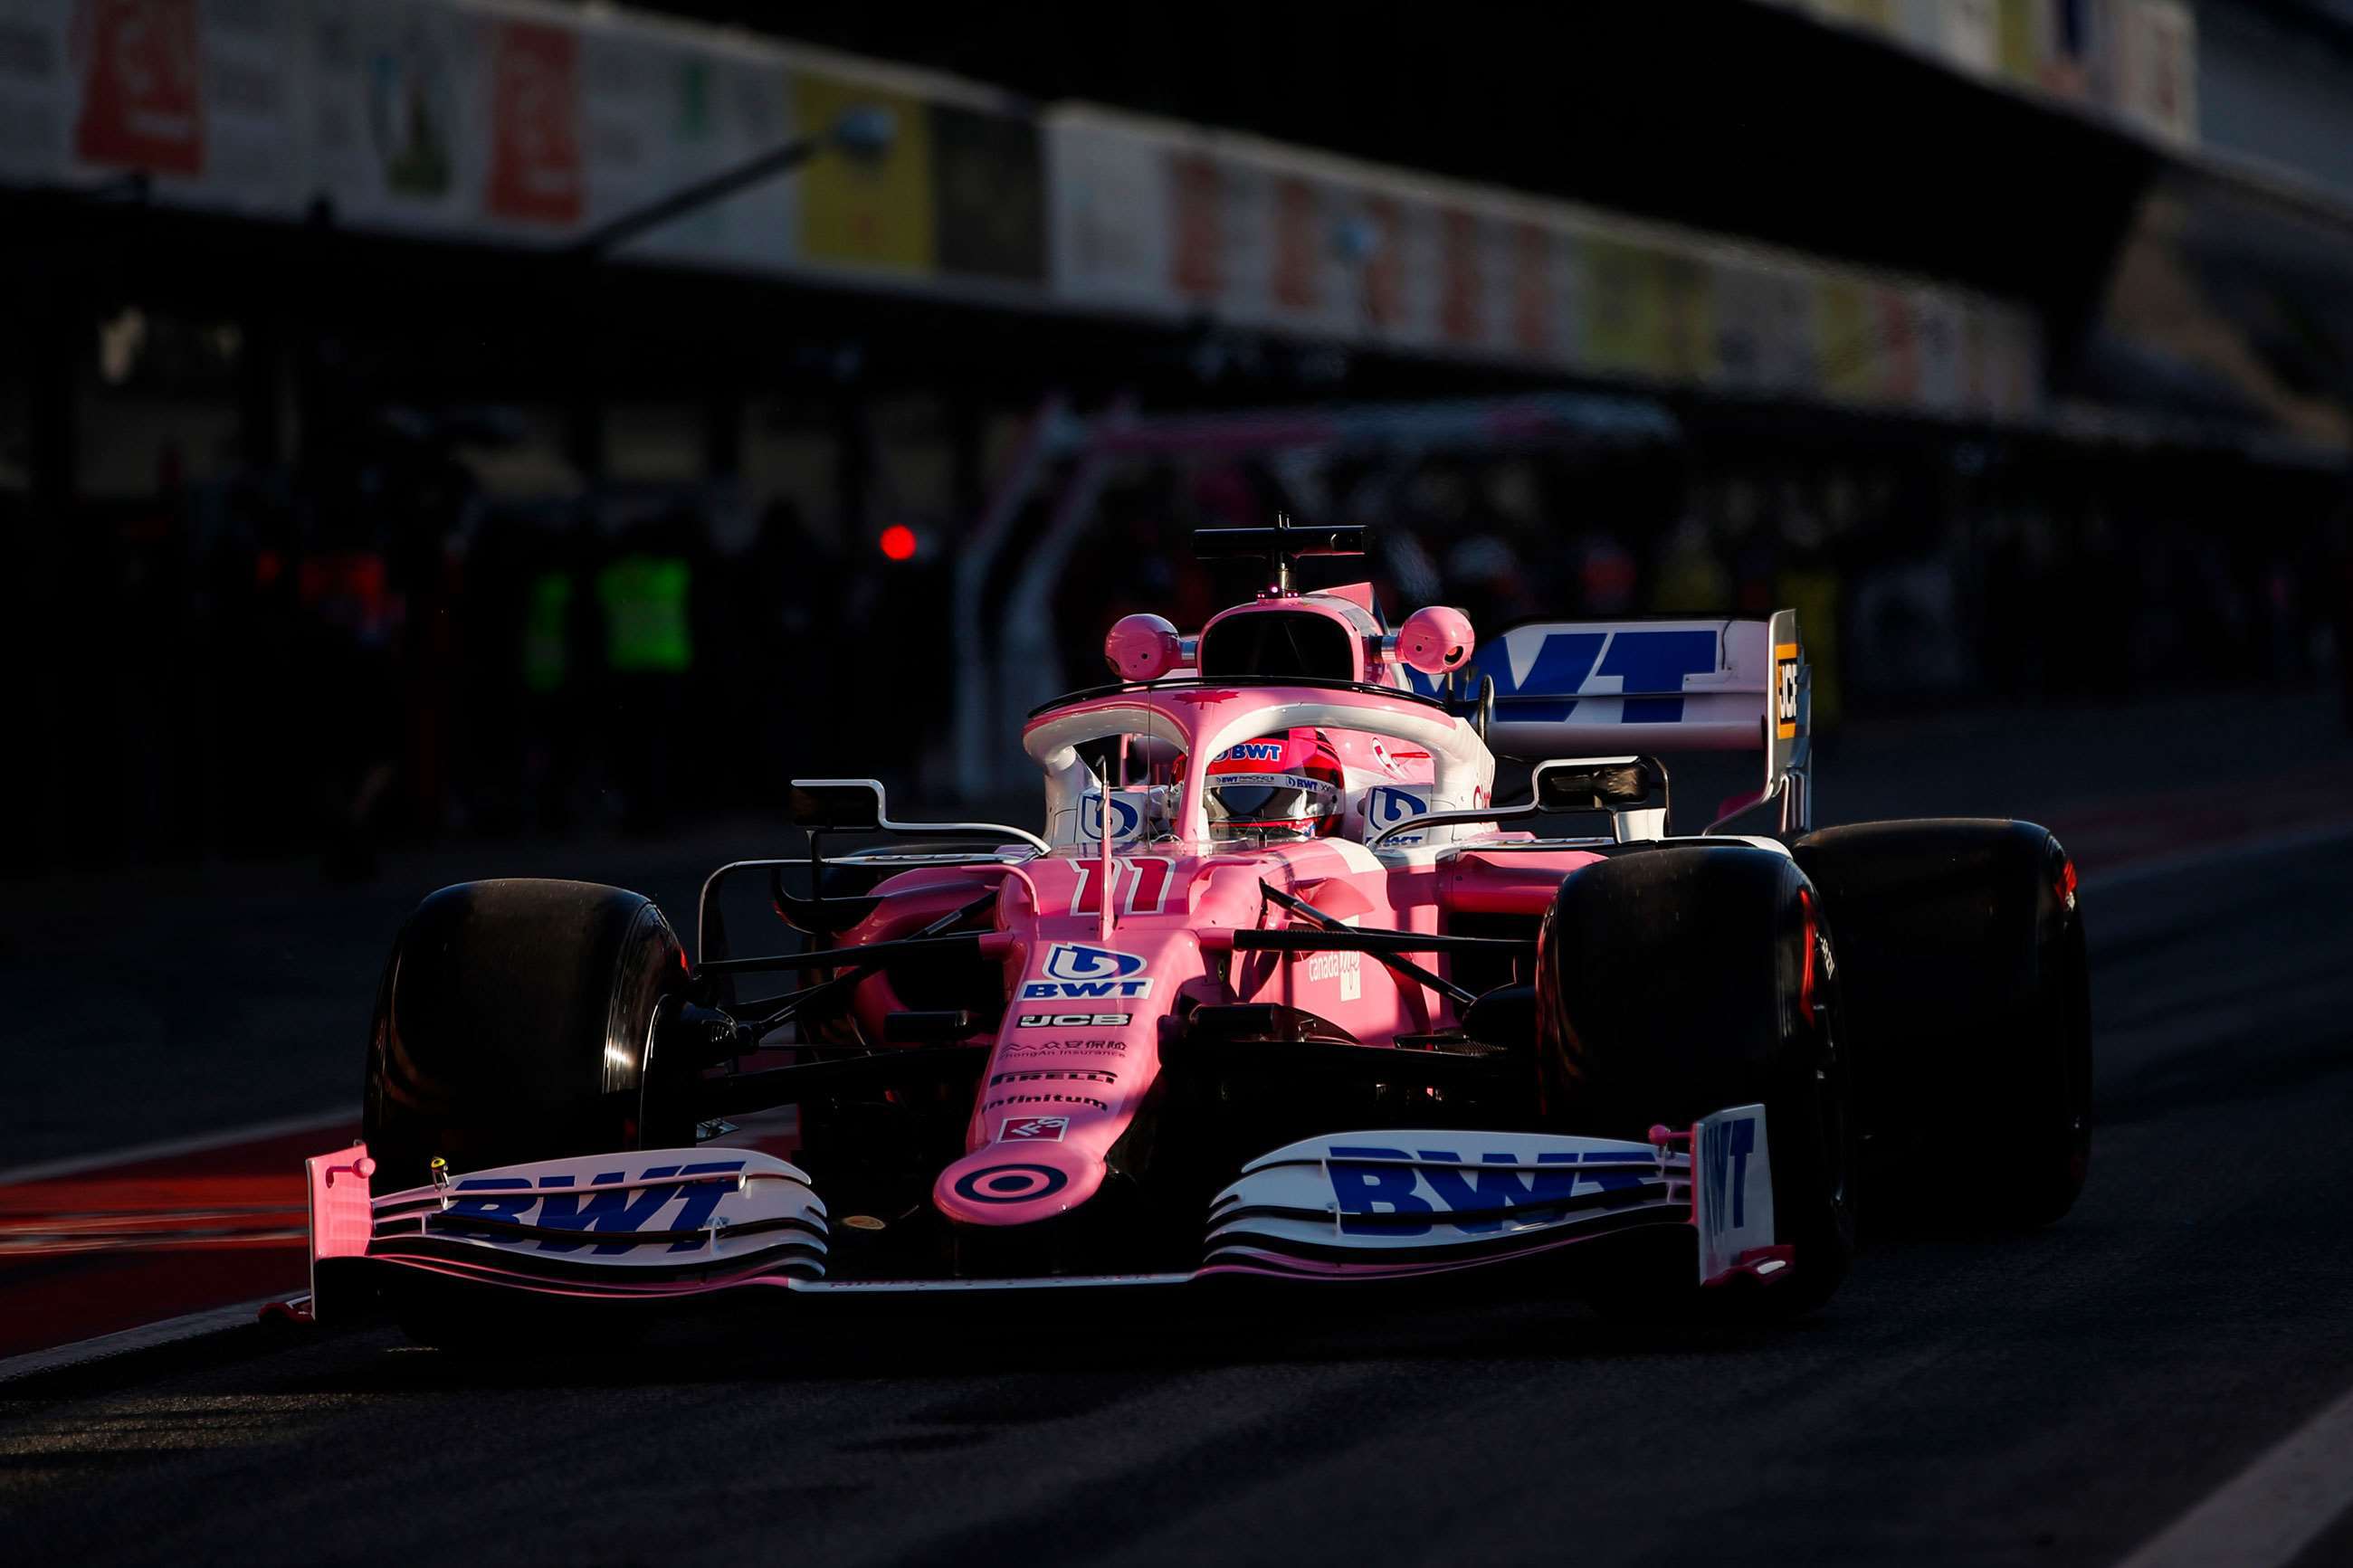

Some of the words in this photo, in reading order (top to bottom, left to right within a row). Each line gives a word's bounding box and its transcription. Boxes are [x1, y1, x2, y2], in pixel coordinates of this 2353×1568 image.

[1403, 631, 1718, 724] WT
[1231, 744, 1281, 762] BWT
[1297, 778, 1318, 791] BWT
[1067, 856, 1176, 917] 11
[1309, 952, 1339, 983] canada
[1023, 981, 1147, 999] BWT
[1020, 1013, 1129, 1026] JCB
[990, 1069, 1119, 1087] PIRELLI
[981, 1093, 1109, 1115] infinitum
[1011, 1116, 1064, 1136] IFS
[1703, 1118, 1755, 1237] WT
[1330, 1147, 1658, 1236] BWT
[424, 1162, 746, 1256] BWT
